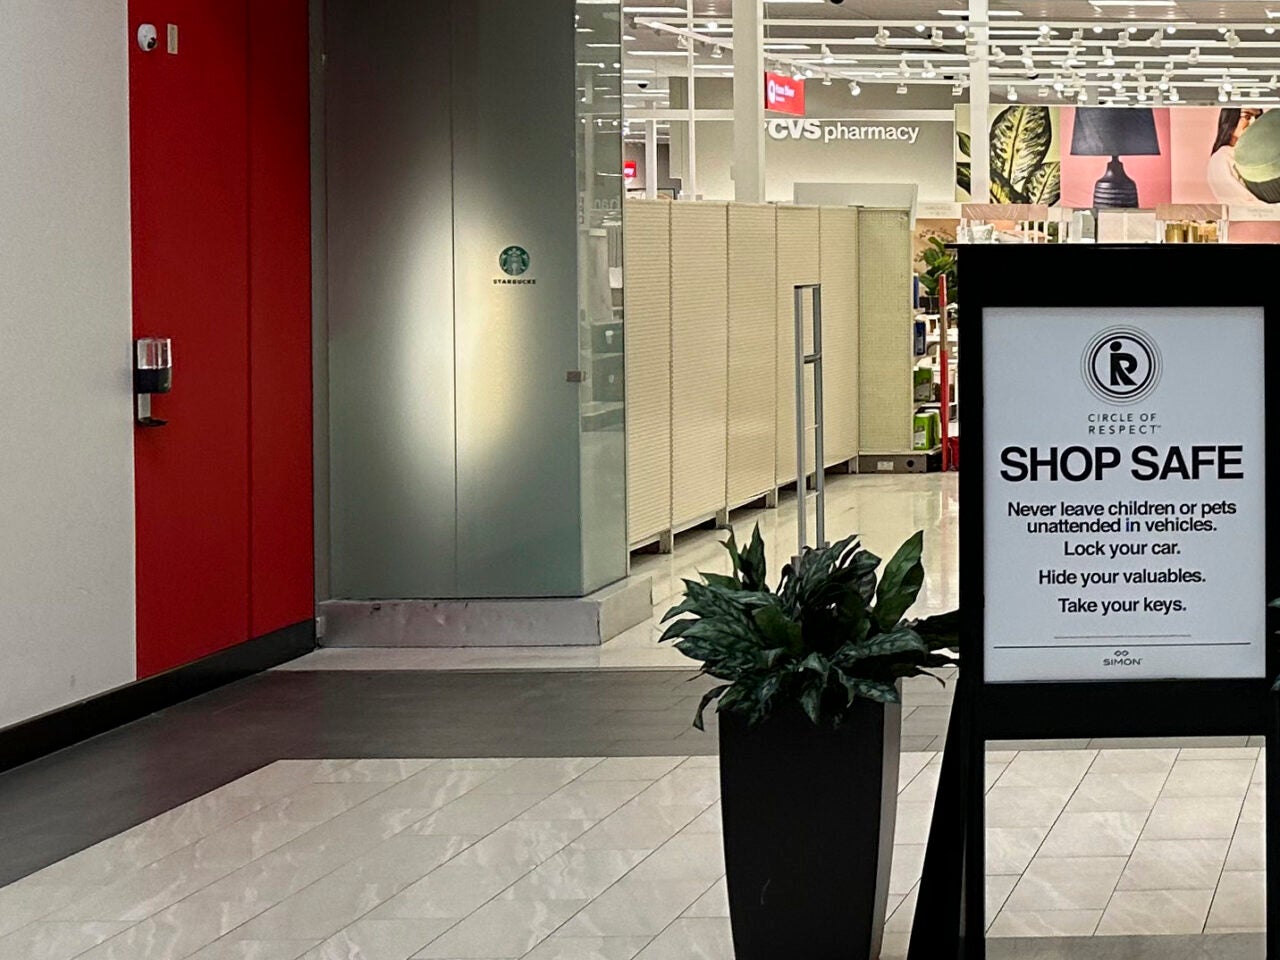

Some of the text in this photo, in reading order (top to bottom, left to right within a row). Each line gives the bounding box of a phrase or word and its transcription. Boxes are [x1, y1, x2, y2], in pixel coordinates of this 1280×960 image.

[768, 119, 919, 143] CVS pharmacy
[1087, 412, 1157, 423] CIRCLE OF
[1000, 445, 1245, 482] SHOP SAFE
[1007, 500, 1237, 519] Never leave children or pets
[1027, 516, 1218, 534] unattended in vehicles.
[1064, 540, 1181, 560] Lock your car.
[1039, 567, 1207, 589] Hide your valuables.
[1057, 596, 1187, 617] Take your keys.
[1103, 658, 1141, 666] SIMON
